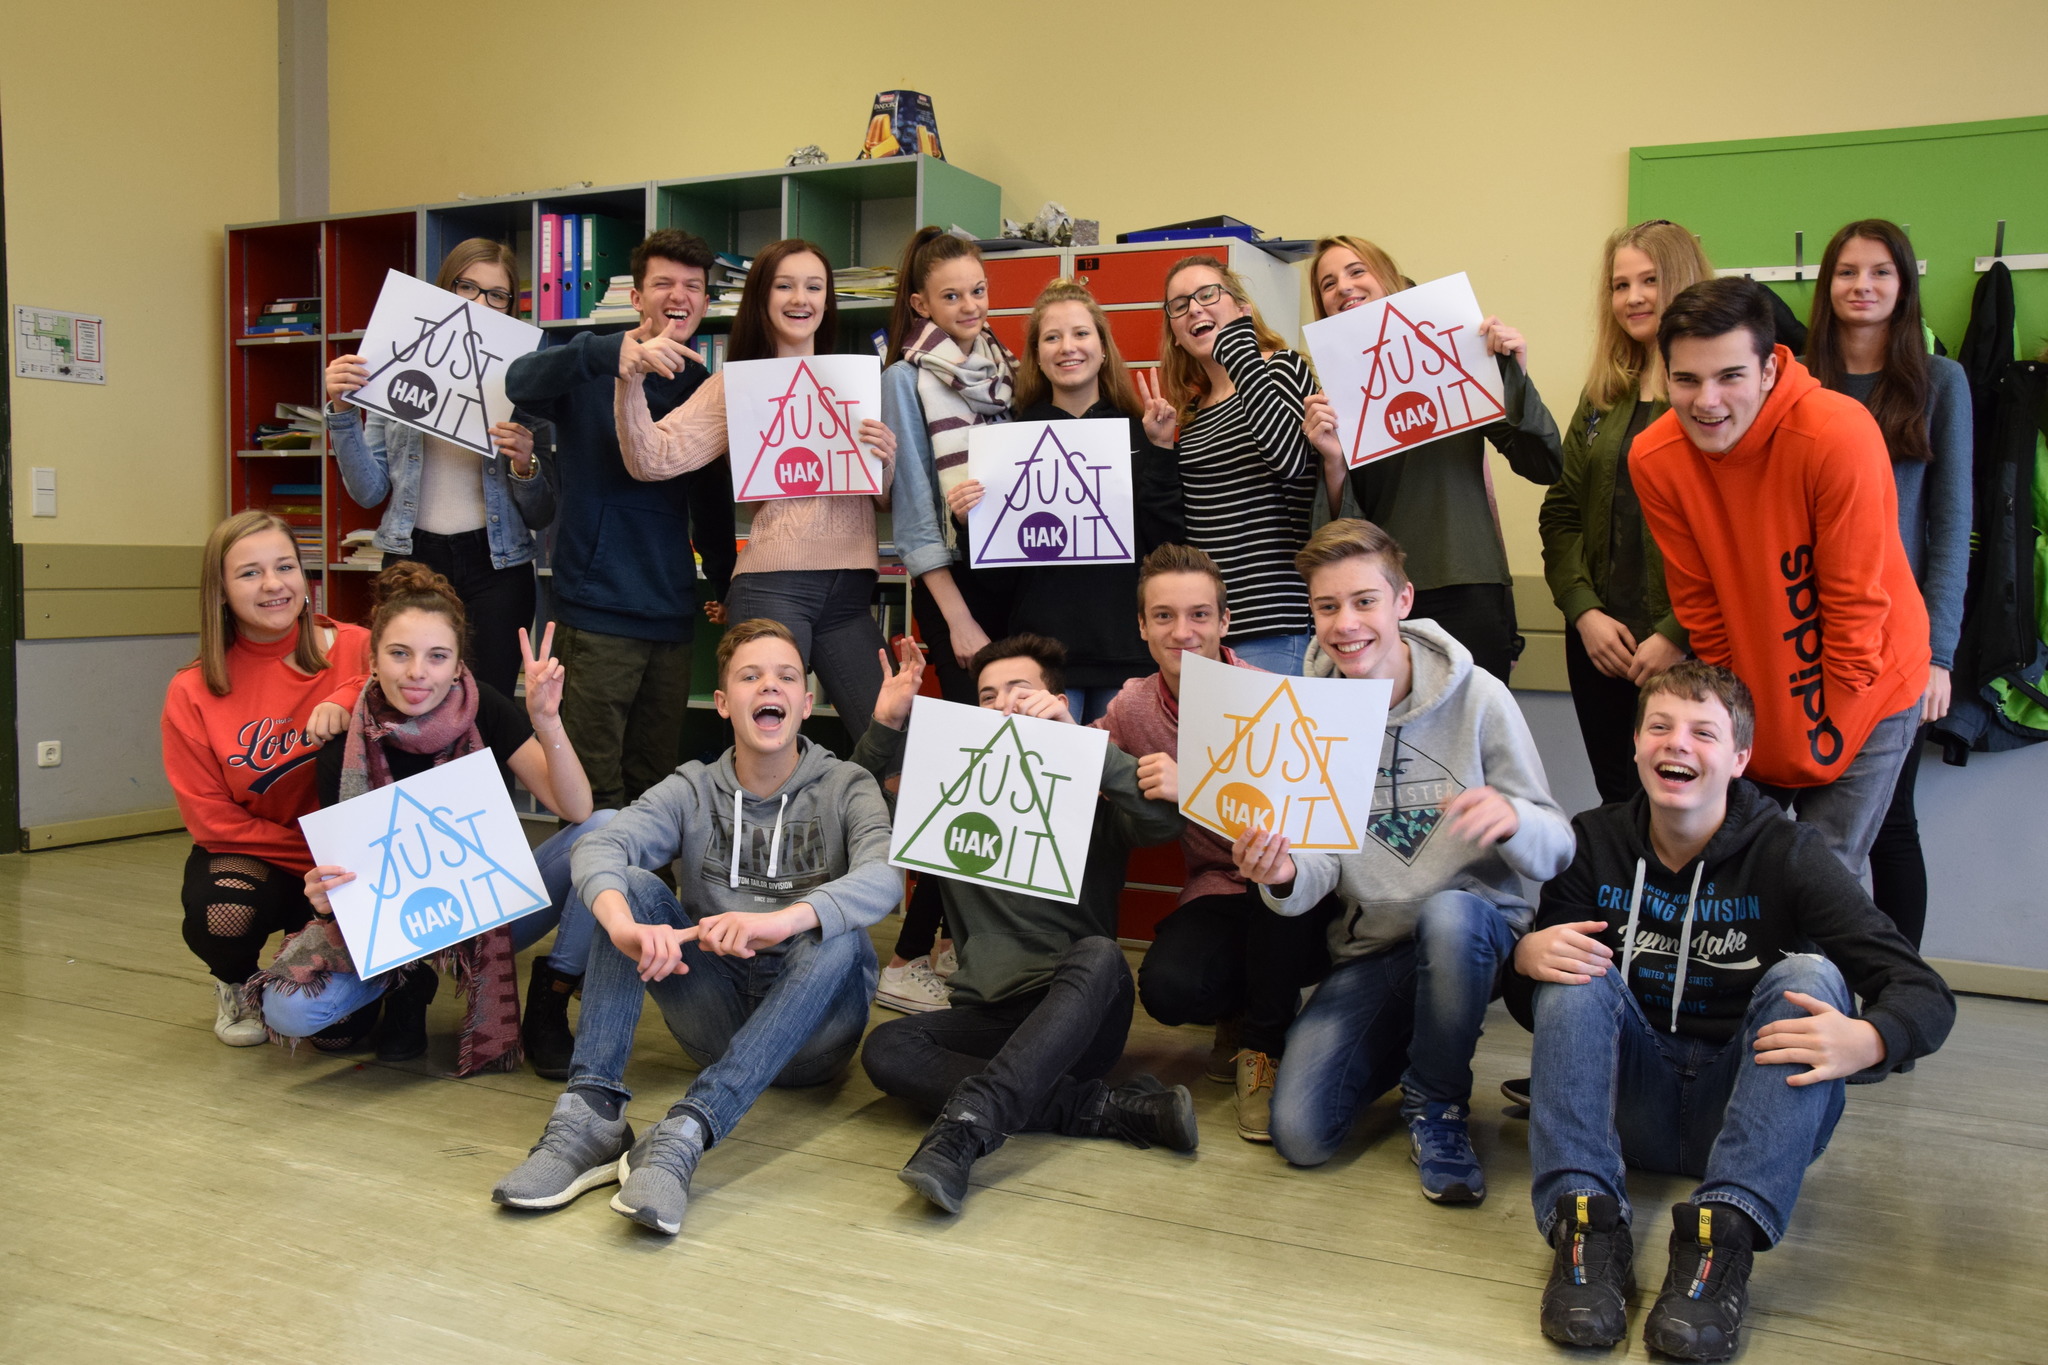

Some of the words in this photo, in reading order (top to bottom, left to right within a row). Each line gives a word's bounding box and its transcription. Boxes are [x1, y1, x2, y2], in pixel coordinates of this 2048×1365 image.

[1084, 259, 1093, 269] 13
[392, 316, 504, 390] JUST
[1360, 320, 1464, 400] JUST
[391, 378, 436, 412] HAK
[433, 387, 483, 438] IT
[759, 386, 861, 447] JUST
[1388, 401, 1436, 435] HAK
[1436, 376, 1474, 429] IT
[779, 461, 821, 484] HAK
[827, 449, 859, 492] IT
[1004, 451, 1112, 511] JUST
[1022, 526, 1065, 548] HAK
[1073, 514, 1109, 558] IT
[1780, 544, 1844, 766] adidas
[1206, 713, 1349, 785] JUST
[940, 747, 1072, 820] JUST
[1221, 794, 1273, 832] HAK
[1278, 794, 1331, 845] IT
[369, 806, 487, 900] JUST
[750, 878, 768, 888] TAILOR
[949, 826, 1000, 860] HAK
[1003, 825, 1056, 886] IT
[405, 898, 461, 939] HAK
[459, 866, 506, 928] IT
[1691, 927, 1748, 960] Lake
[1638, 967, 1665, 980] UNITED
[1688, 975, 1714, 987] STATES
